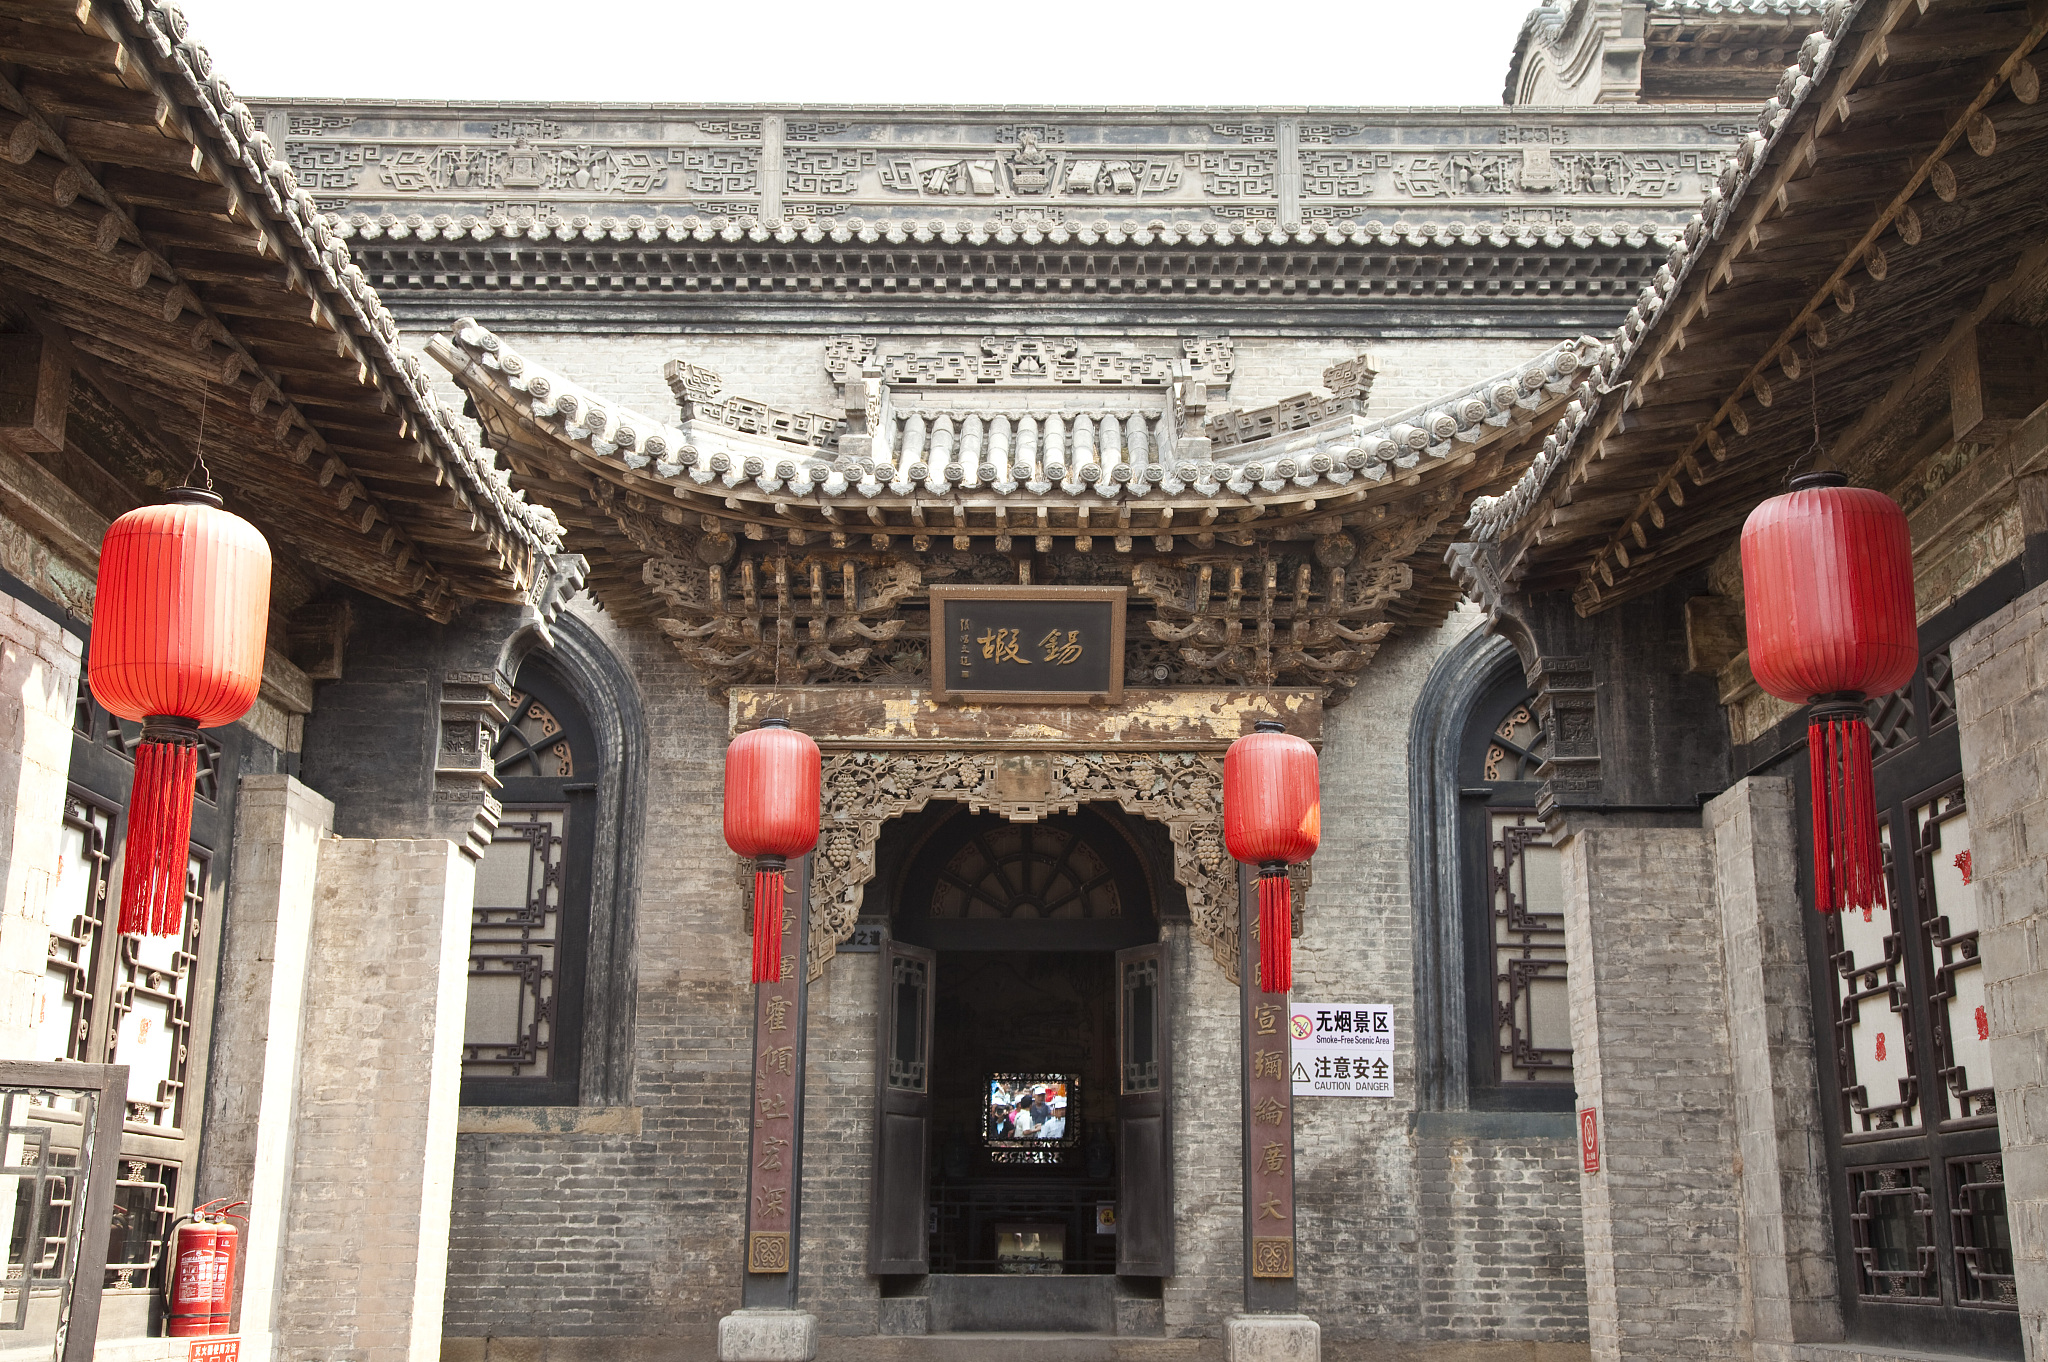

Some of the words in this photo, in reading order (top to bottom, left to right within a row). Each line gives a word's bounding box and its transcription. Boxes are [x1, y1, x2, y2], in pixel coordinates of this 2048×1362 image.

[1316, 1010, 1390, 1033] 无烟景区
[1316, 1035, 1354, 1044] Smoke-Free
[1355, 1036, 1375, 1045] Scenic
[1375, 1036, 1390, 1045] Area
[1314, 1056, 1389, 1079] 注意安全
[1314, 1081, 1351, 1090] CAUTION
[1356, 1082, 1389, 1091] DANGER
